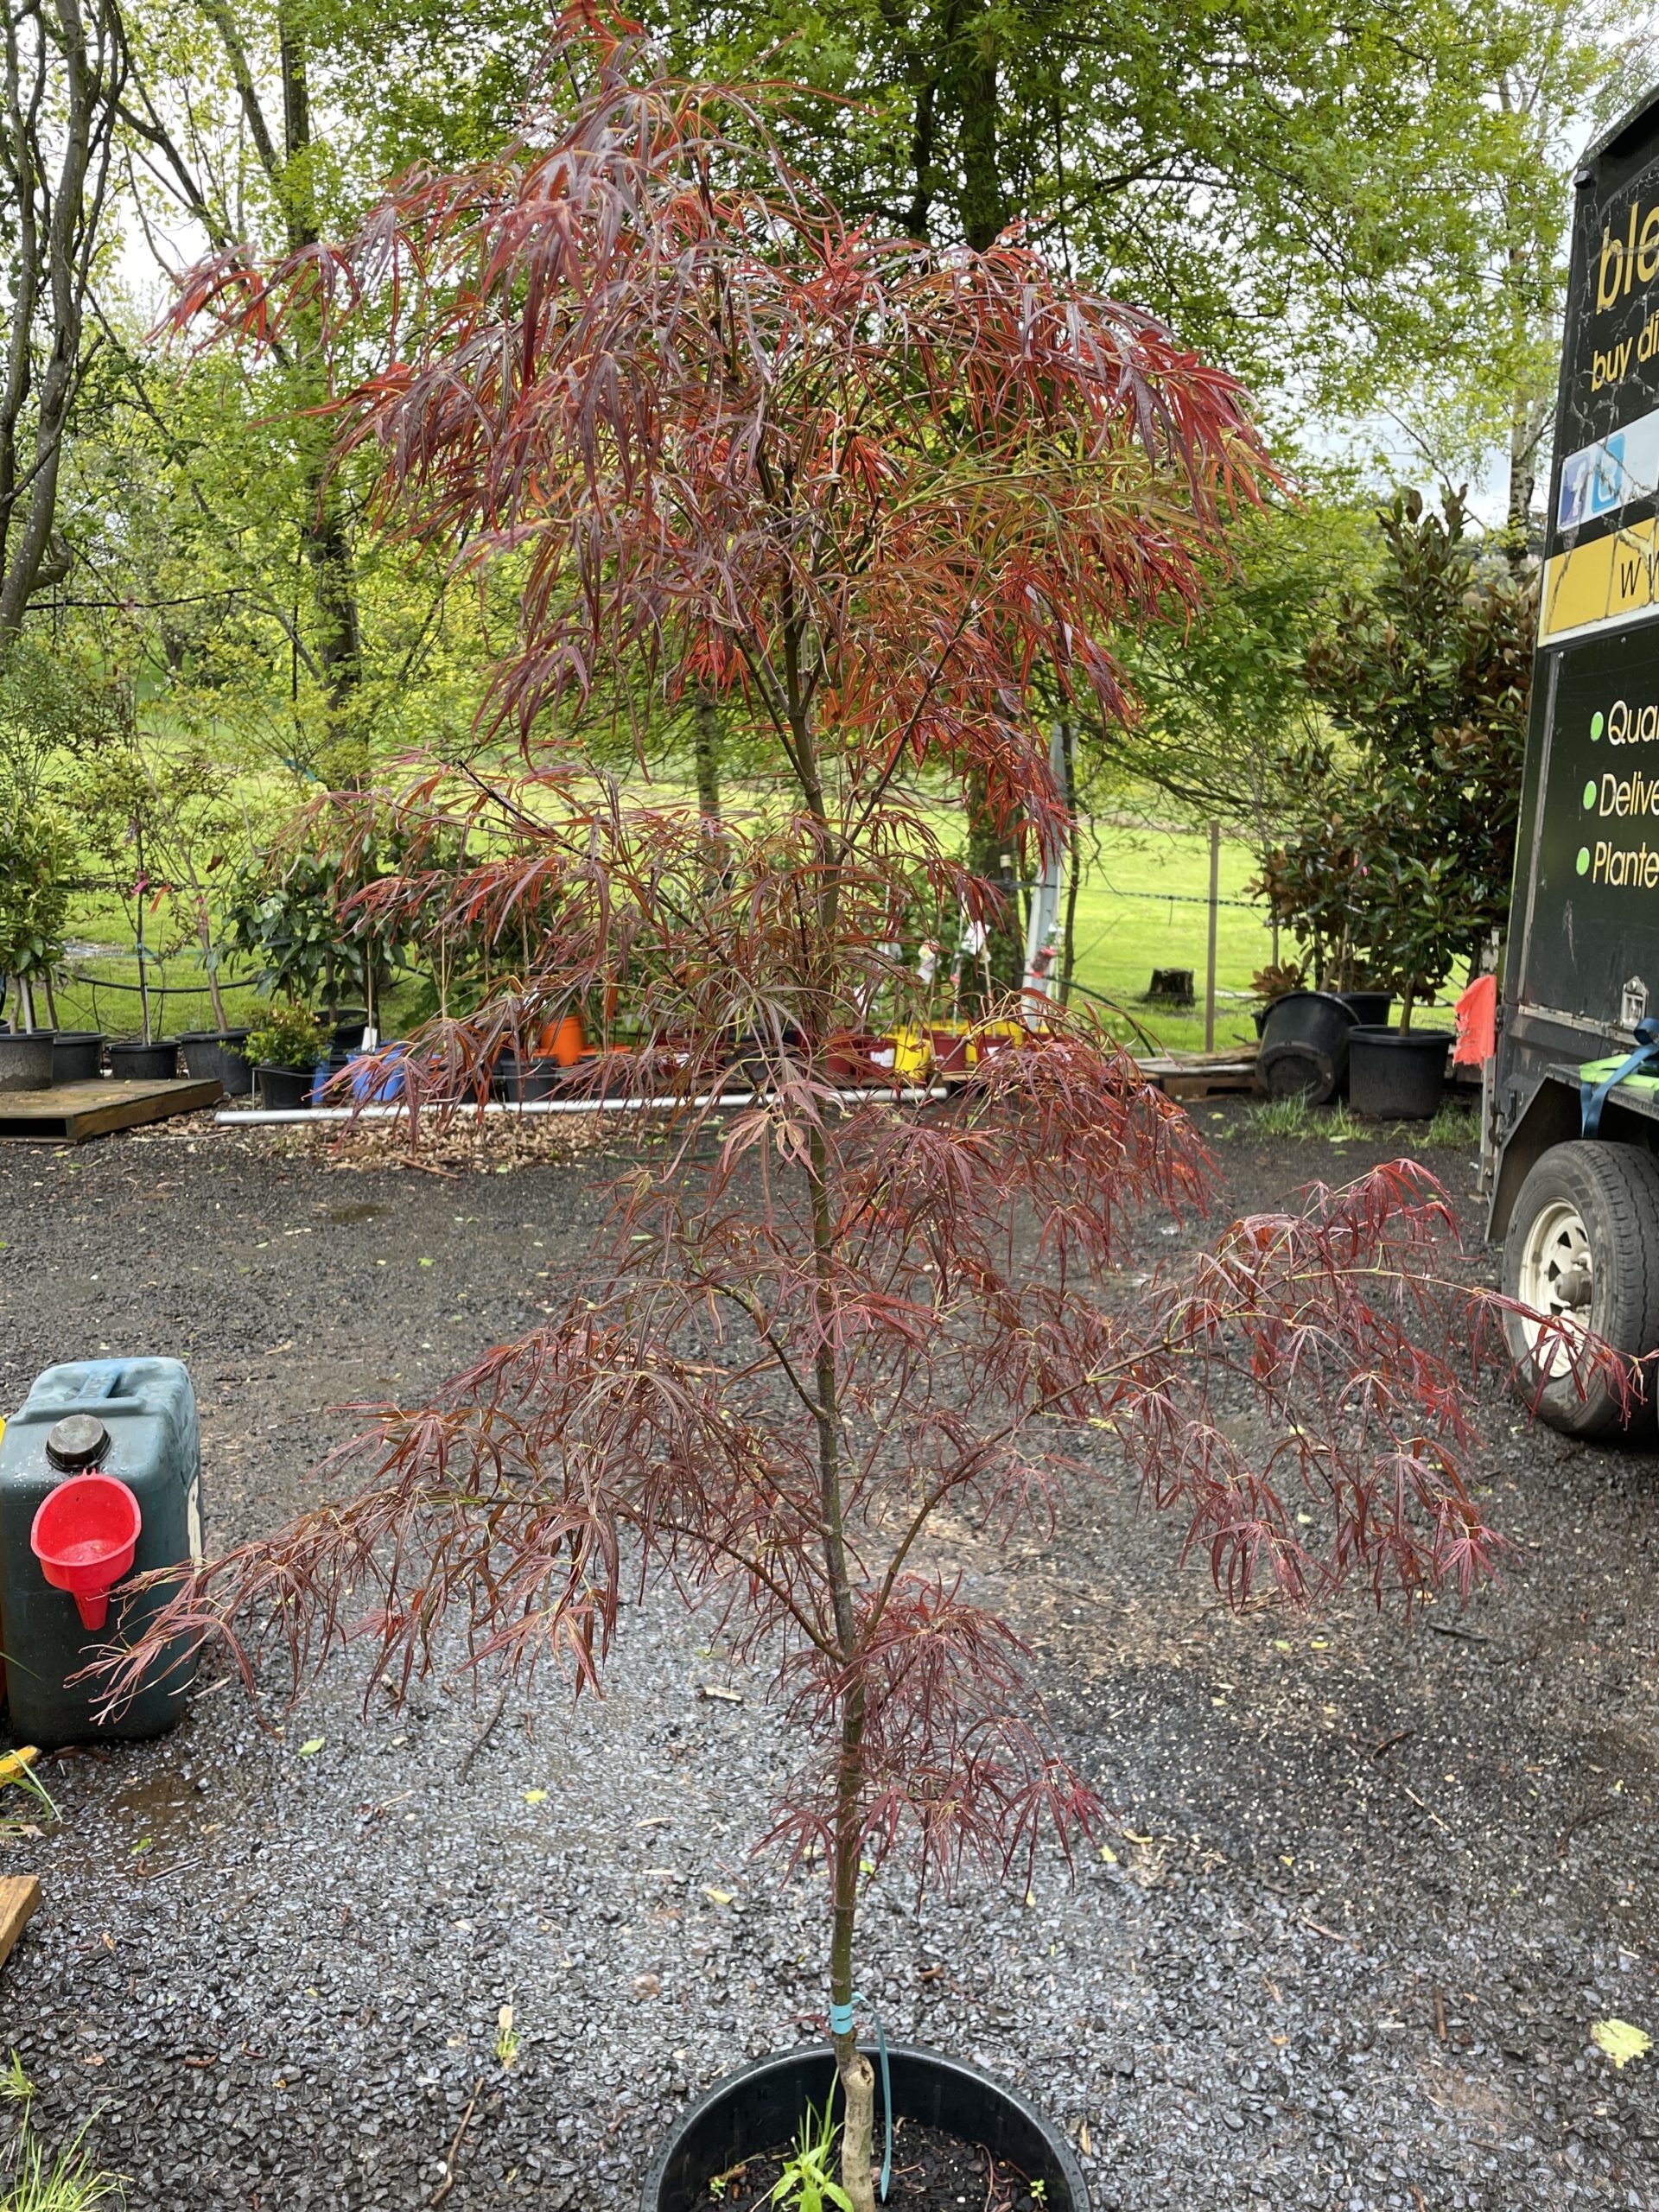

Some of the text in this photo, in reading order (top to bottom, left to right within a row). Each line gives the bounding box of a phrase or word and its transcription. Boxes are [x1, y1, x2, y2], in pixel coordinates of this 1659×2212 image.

[1591, 308, 1659, 392] buy di
[1608, 700, 1659, 746] Qua
[1592, 841, 1659, 888] Plante
